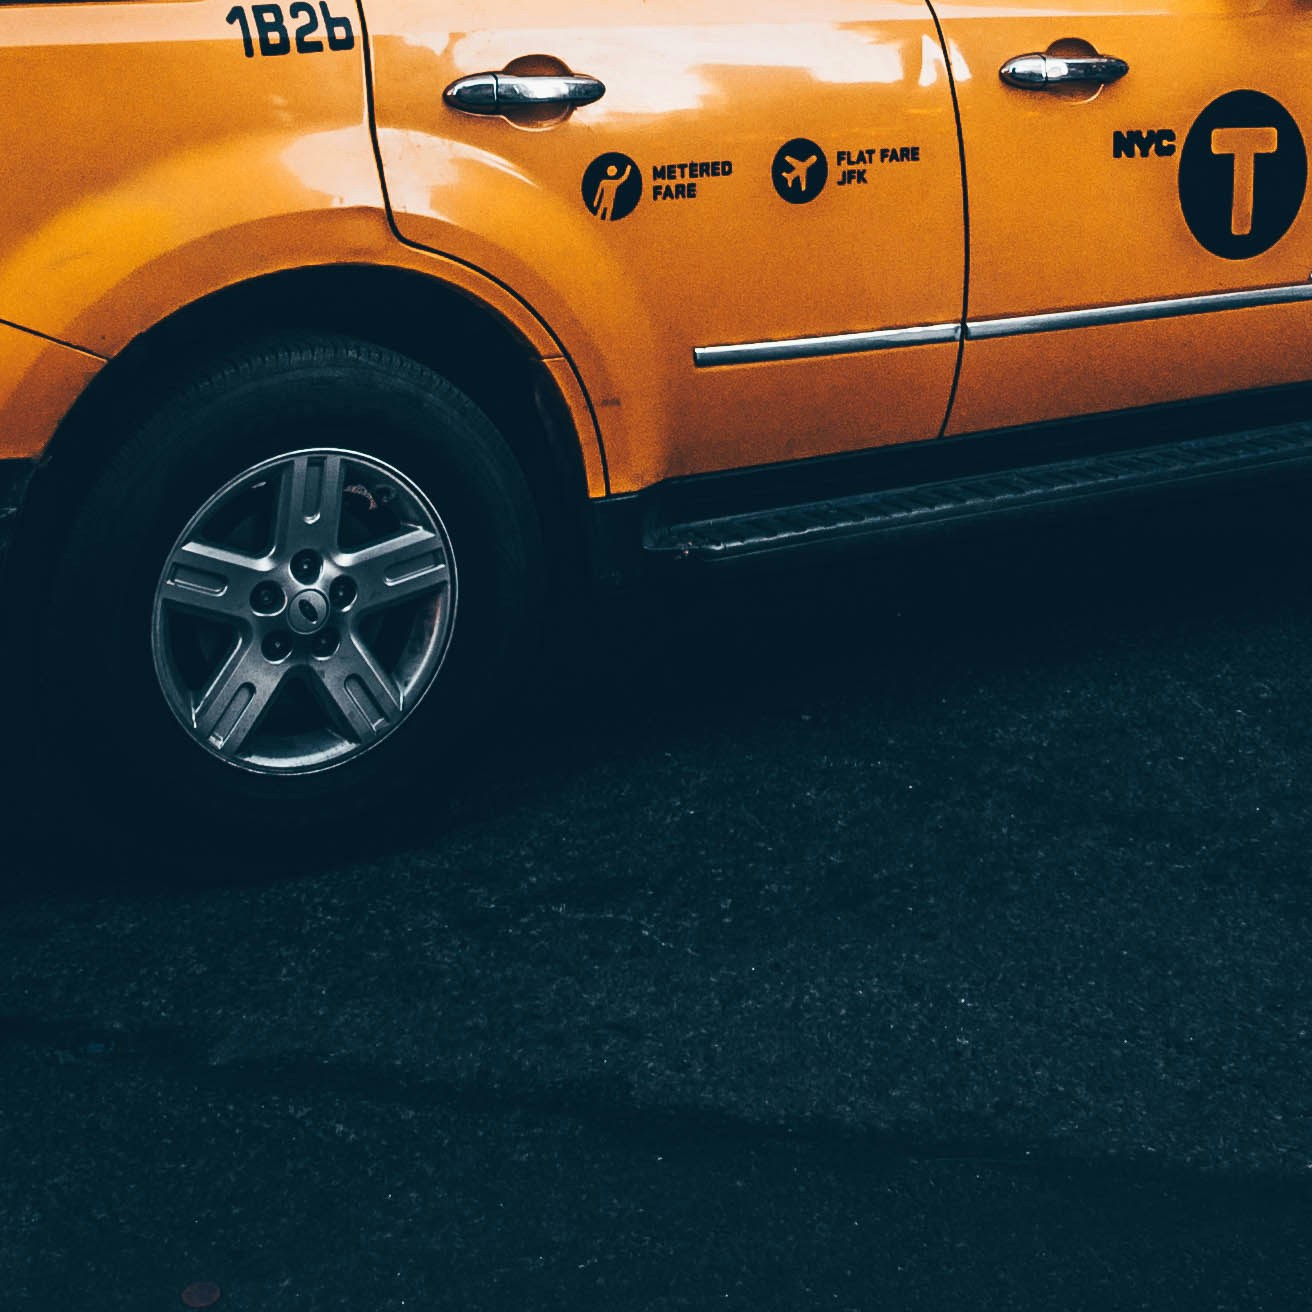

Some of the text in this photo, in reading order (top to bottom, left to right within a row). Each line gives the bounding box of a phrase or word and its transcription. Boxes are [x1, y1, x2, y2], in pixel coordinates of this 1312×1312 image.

[226, 1, 355, 58] 1B26
[1113, 129, 1176, 158] NYC
[837, 146, 921, 167] FLAT FARE
[652, 160, 733, 181] METERED
[837, 169, 868, 186] JFK
[652, 183, 698, 202] FARE
